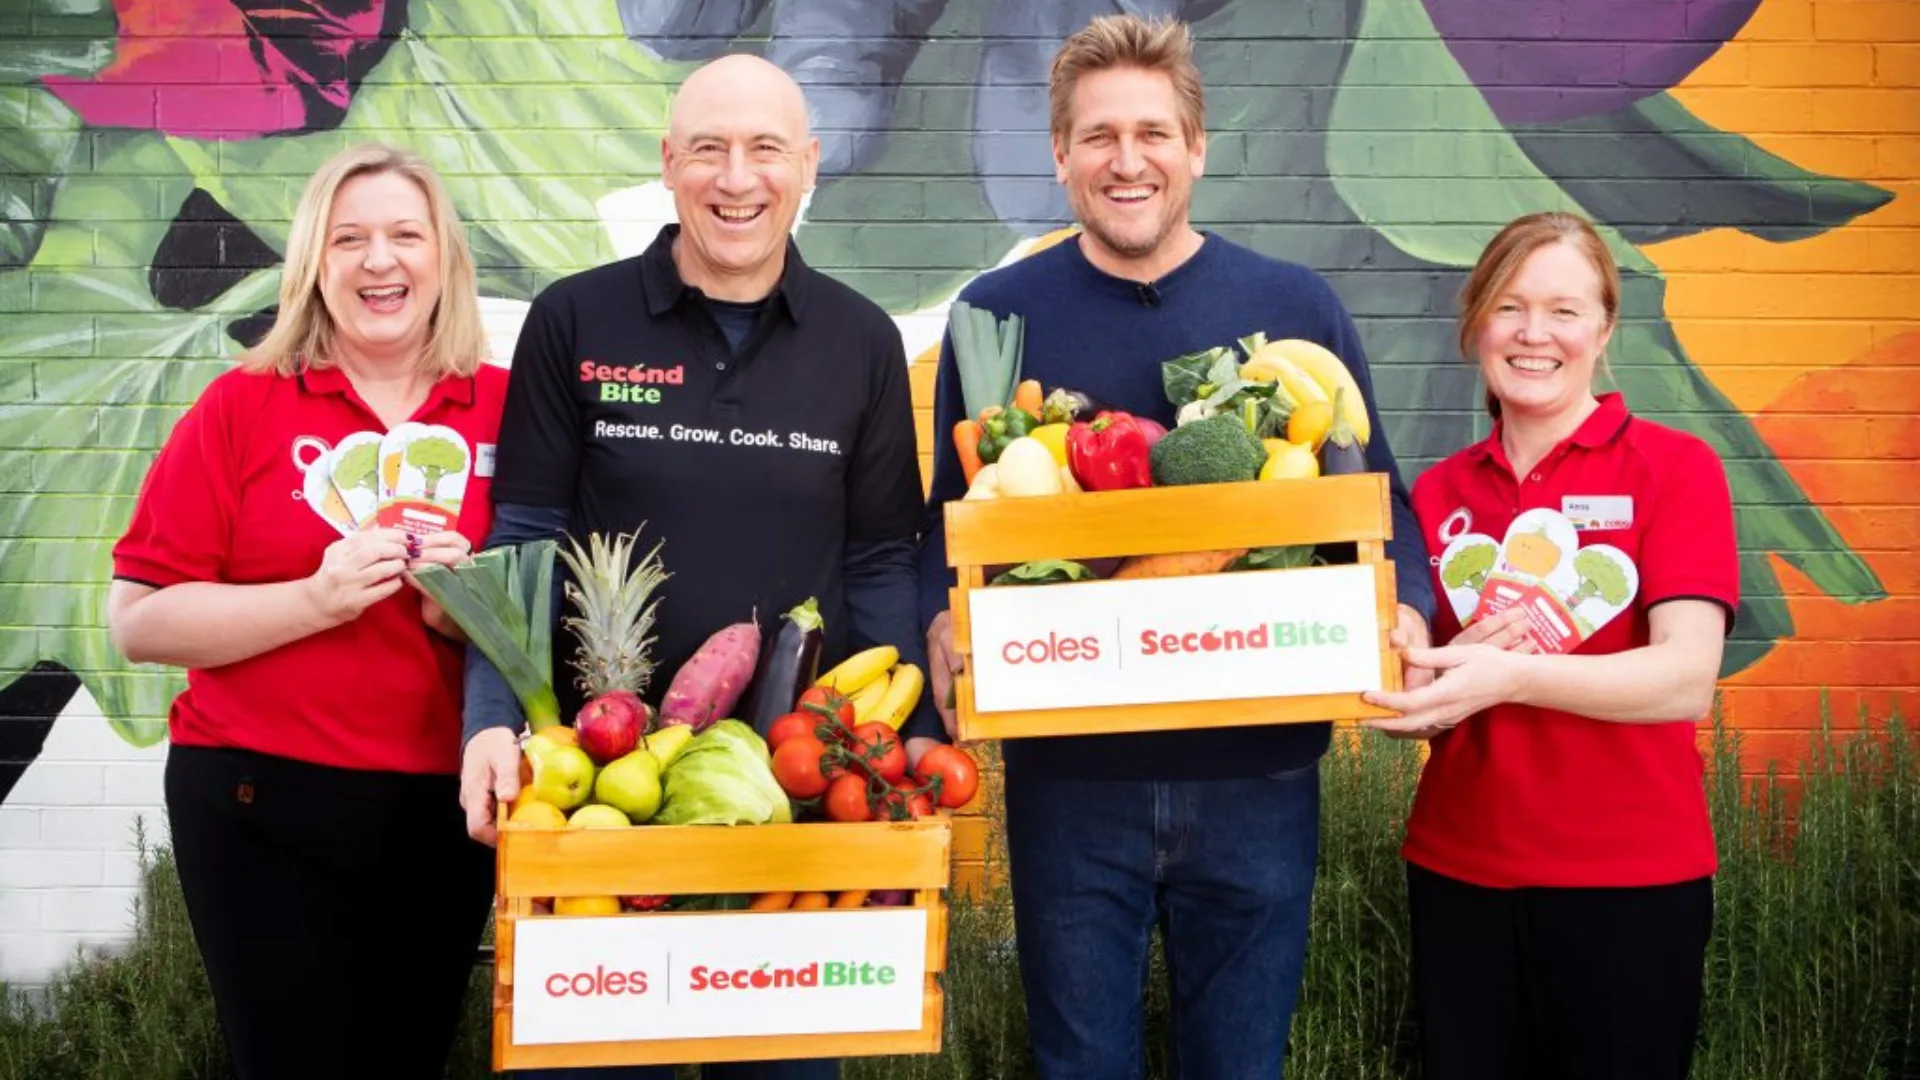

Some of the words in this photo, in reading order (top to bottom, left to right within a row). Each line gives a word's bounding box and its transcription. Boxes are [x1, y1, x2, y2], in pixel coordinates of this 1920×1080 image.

[579, 360, 684, 385] Second
[600, 383, 661, 404] Bite
[595, 420, 664, 440] Rescue.
[669, 423, 724, 444] Grow.
[729, 428, 784, 448] Cook.
[788, 432, 842, 455] Share.
[1002, 632, 1100, 664] coles
[545, 964, 648, 998] coles
